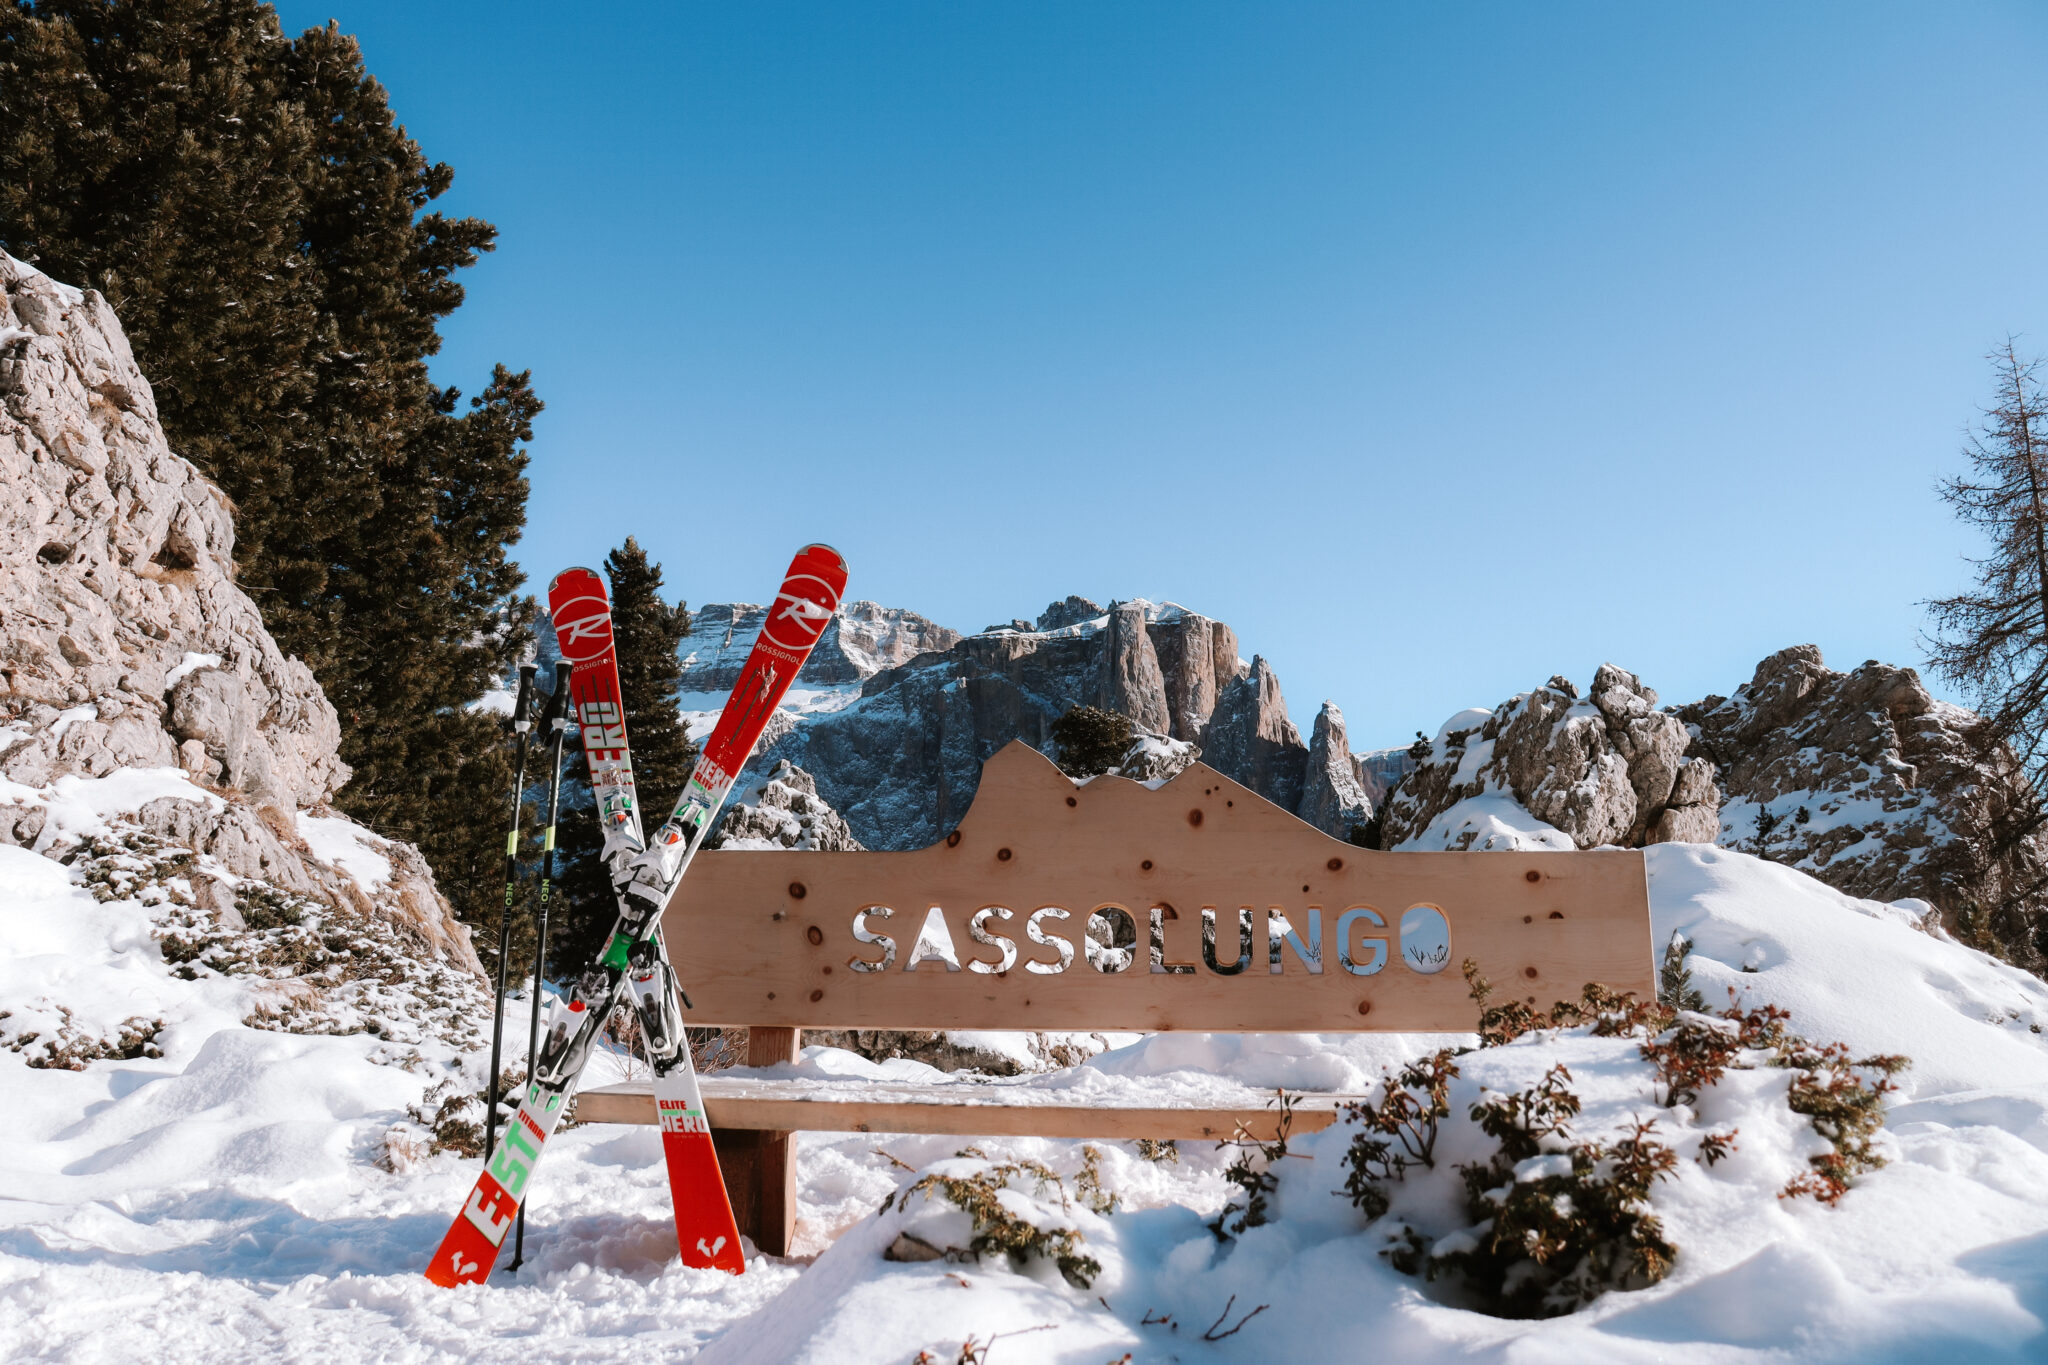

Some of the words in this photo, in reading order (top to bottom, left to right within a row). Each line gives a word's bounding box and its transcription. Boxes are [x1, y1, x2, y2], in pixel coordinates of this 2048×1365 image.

[755, 642, 801, 666] ROSSIGNOL
[848, 903, 1453, 976] SASSOLUNGO
[659, 1100, 687, 1110] ELITE
[660, 1115, 709, 1133] HERO
